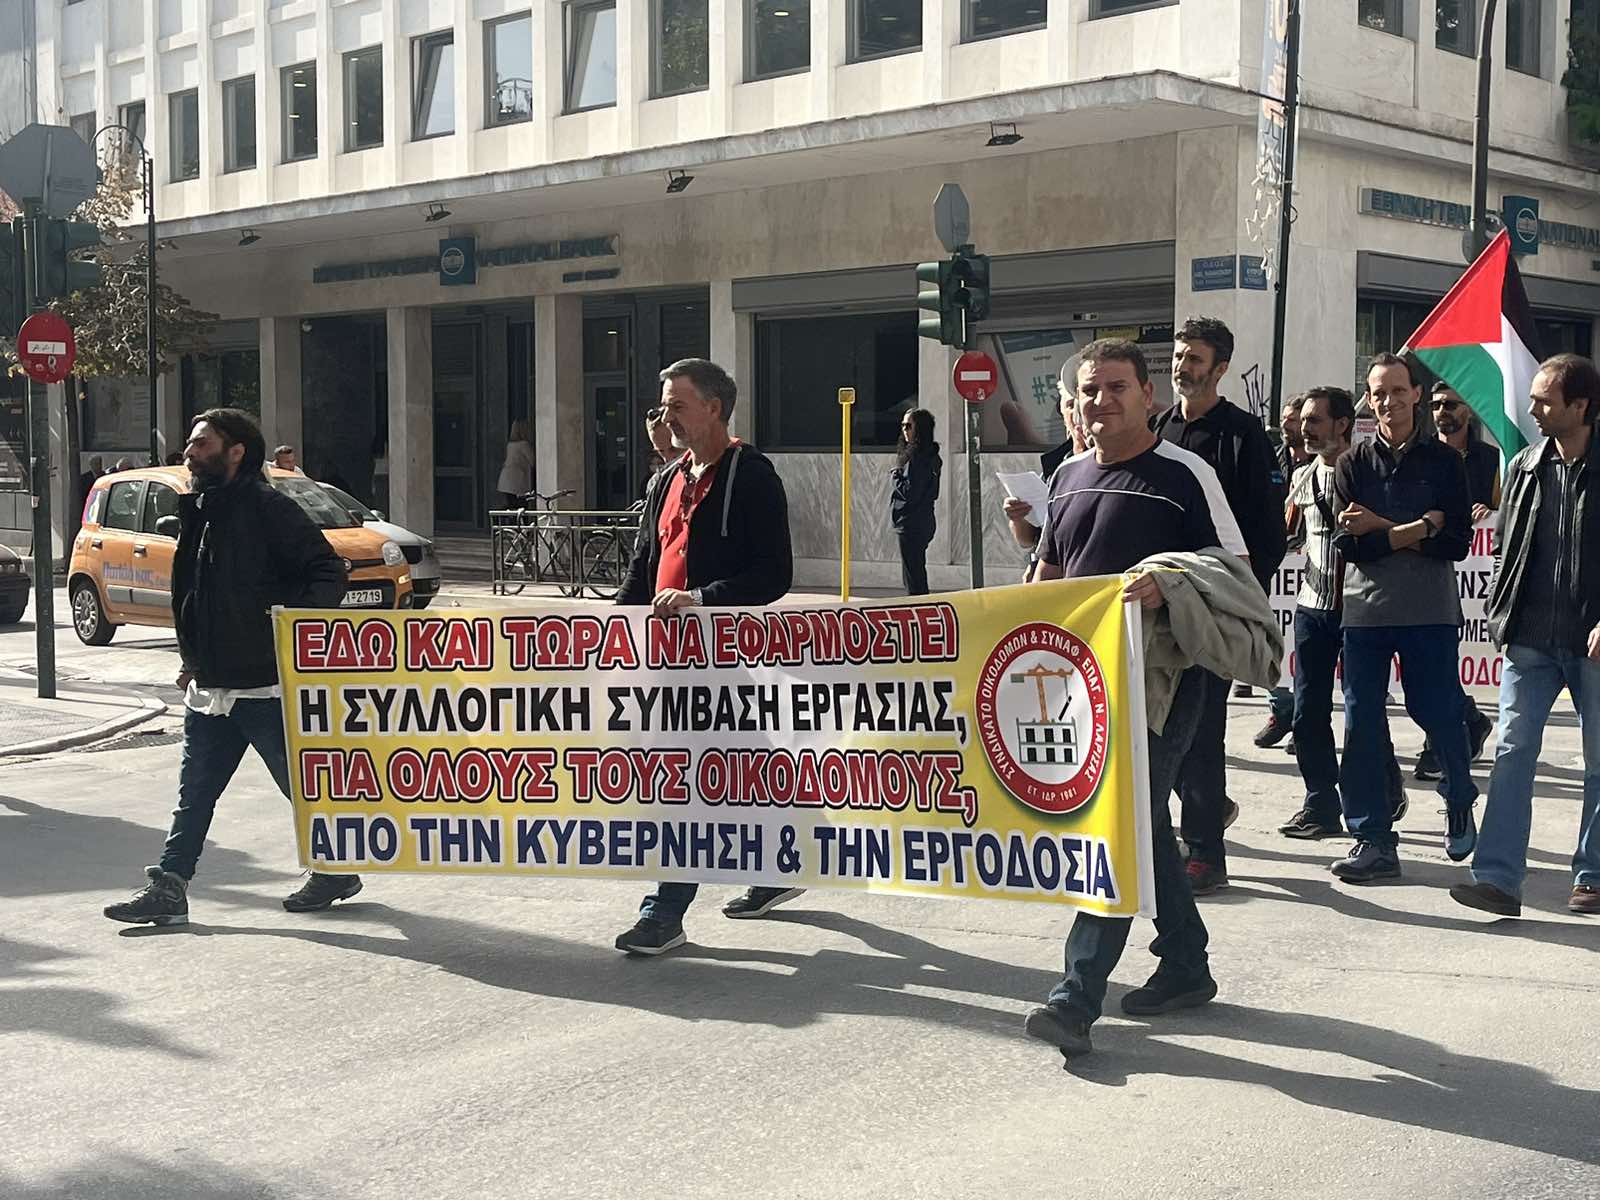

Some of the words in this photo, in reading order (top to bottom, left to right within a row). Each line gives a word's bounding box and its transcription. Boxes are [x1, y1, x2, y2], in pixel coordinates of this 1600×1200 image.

[294, 616, 397, 672] ΕΔΩ
[405, 616, 493, 671] ΚΑΙ
[502, 615, 640, 671] ΤΩΡΑ
[646, 614, 708, 669] ΝΑ
[710, 602, 959, 667] ΕΦΑΡΜΟΣΤΕΙ
[982, 632, 1028, 699] ΟΙΚΟΔΟΜΩΝ
[1030, 629, 1038, 644] &
[301, 689, 329, 733] Η
[344, 687, 590, 733] ΣΥΛΛΟΓΙΚΗ
[607, 684, 779, 733] ΣΥΜΒΑΣΗ
[792, 681, 966, 744] ΕΡΓΑΣΙΑΣ,
[981, 704, 1016, 781] ΣΥΝΔΙΚΑΤΟ
[299, 748, 381, 802] ΓΙΑ
[388, 747, 558, 803] ΟΛΟΥΣ
[563, 748, 692, 804] ΤΟΥΣ
[696, 748, 979, 827] ΟΙΚΟΔΟΜΟΥΣ,
[311, 816, 398, 861] ΑΠΟ
[411, 818, 500, 864] ΤΗΝ
[517, 819, 762, 873] ΚΥΒΕΡΝΗΣΗ
[777, 825, 801, 874] &
[814, 826, 891, 879] ΤΗΝ
[903, 830, 1117, 899] ΕΡΓΟΔΟΣΙΑ
